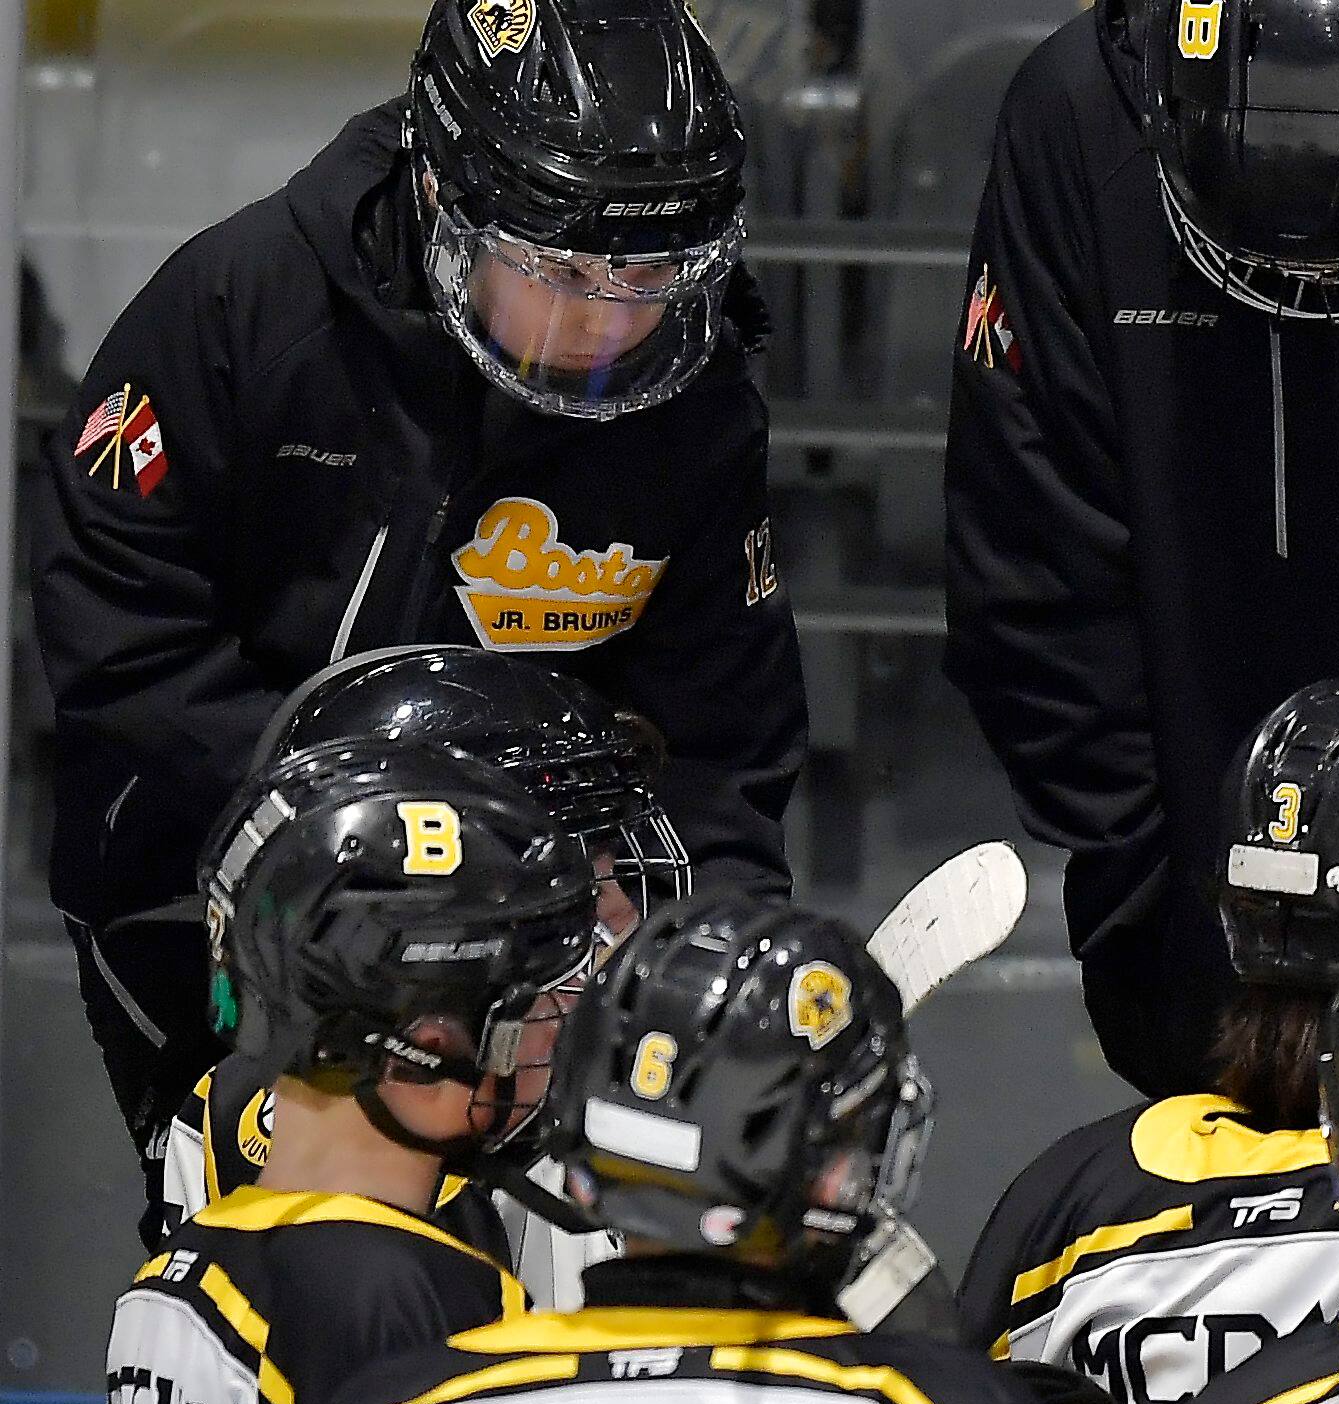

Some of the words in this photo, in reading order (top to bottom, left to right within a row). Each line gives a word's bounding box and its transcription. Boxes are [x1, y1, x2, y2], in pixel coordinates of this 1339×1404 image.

[1178, 0, 1223, 59] B
[602, 200, 697, 217] BAUER
[1113, 309, 1219, 327] BAUER
[276, 444, 357, 468] BAUER
[455, 500, 656, 597] Bosto
[744, 517, 778, 607] 12
[491, 610, 531, 631] JR.
[543, 607, 632, 632] BRUINS
[396, 800, 463, 875] B
[1268, 782, 1302, 843] 3
[630, 1031, 678, 1100] 6
